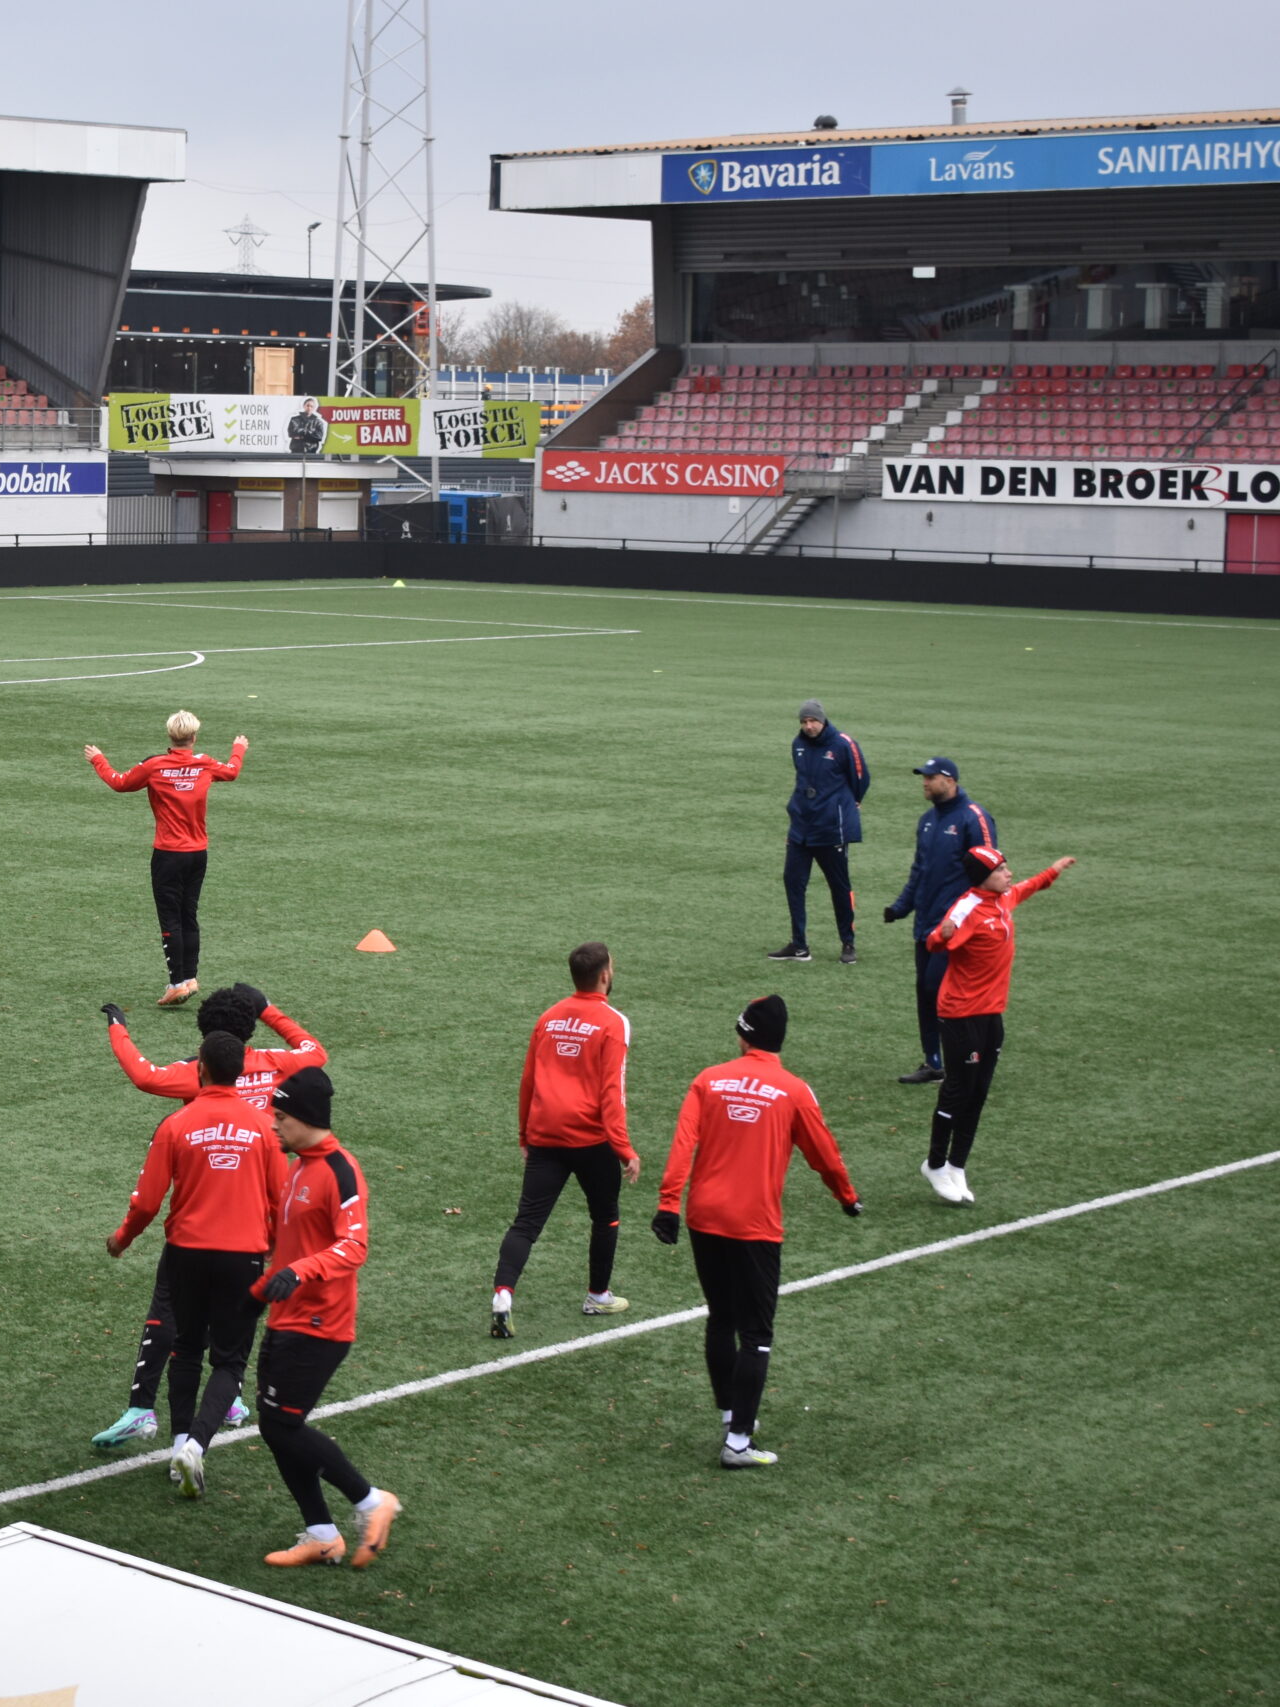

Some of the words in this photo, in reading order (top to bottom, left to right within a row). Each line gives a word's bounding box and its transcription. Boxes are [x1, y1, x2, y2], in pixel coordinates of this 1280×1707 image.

[721, 154, 842, 192] Bavaria
[929, 157, 1016, 182] Lavans
[125, 399, 206, 424] LOGISTIC
[240, 404, 268, 416] WORK
[331, 409, 361, 422] JOUW
[363, 408, 401, 421] BETERE
[436, 406, 519, 430] LOGISTIC
[127, 416, 211, 444] FORCE
[240, 419, 271, 431] LEARN
[360, 424, 407, 444] BAAN
[438, 422, 523, 450] FORCE
[240, 434, 279, 446] RECRUIT
[594, 461, 679, 486] JACK'S
[685, 463, 780, 488] CASINO
[886, 464, 965, 495] VAN
[980, 466, 1057, 498] DEN
[1073, 468, 1210, 501] BROEK
[235, 1070, 277, 1088] aller
[185, 1122, 262, 1146] saller
